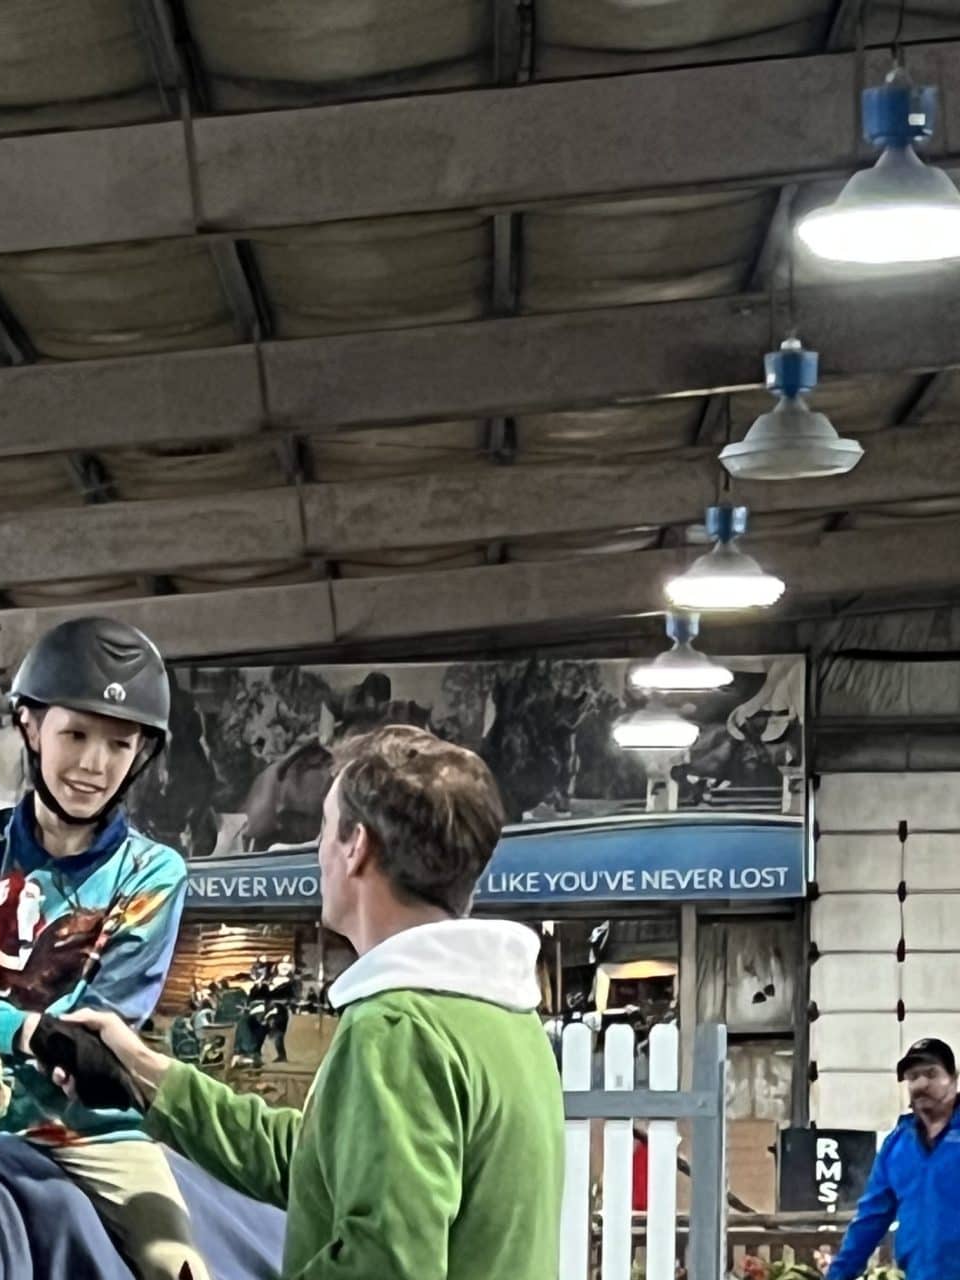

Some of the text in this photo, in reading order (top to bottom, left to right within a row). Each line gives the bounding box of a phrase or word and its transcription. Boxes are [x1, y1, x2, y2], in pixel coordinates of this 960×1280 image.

[187, 876, 319, 897] NEVER WO
[487, 871, 540, 893] LIKE
[544, 869, 636, 893] YOU'VE
[640, 868, 724, 890] NEVER
[729, 866, 789, 889] LOST
